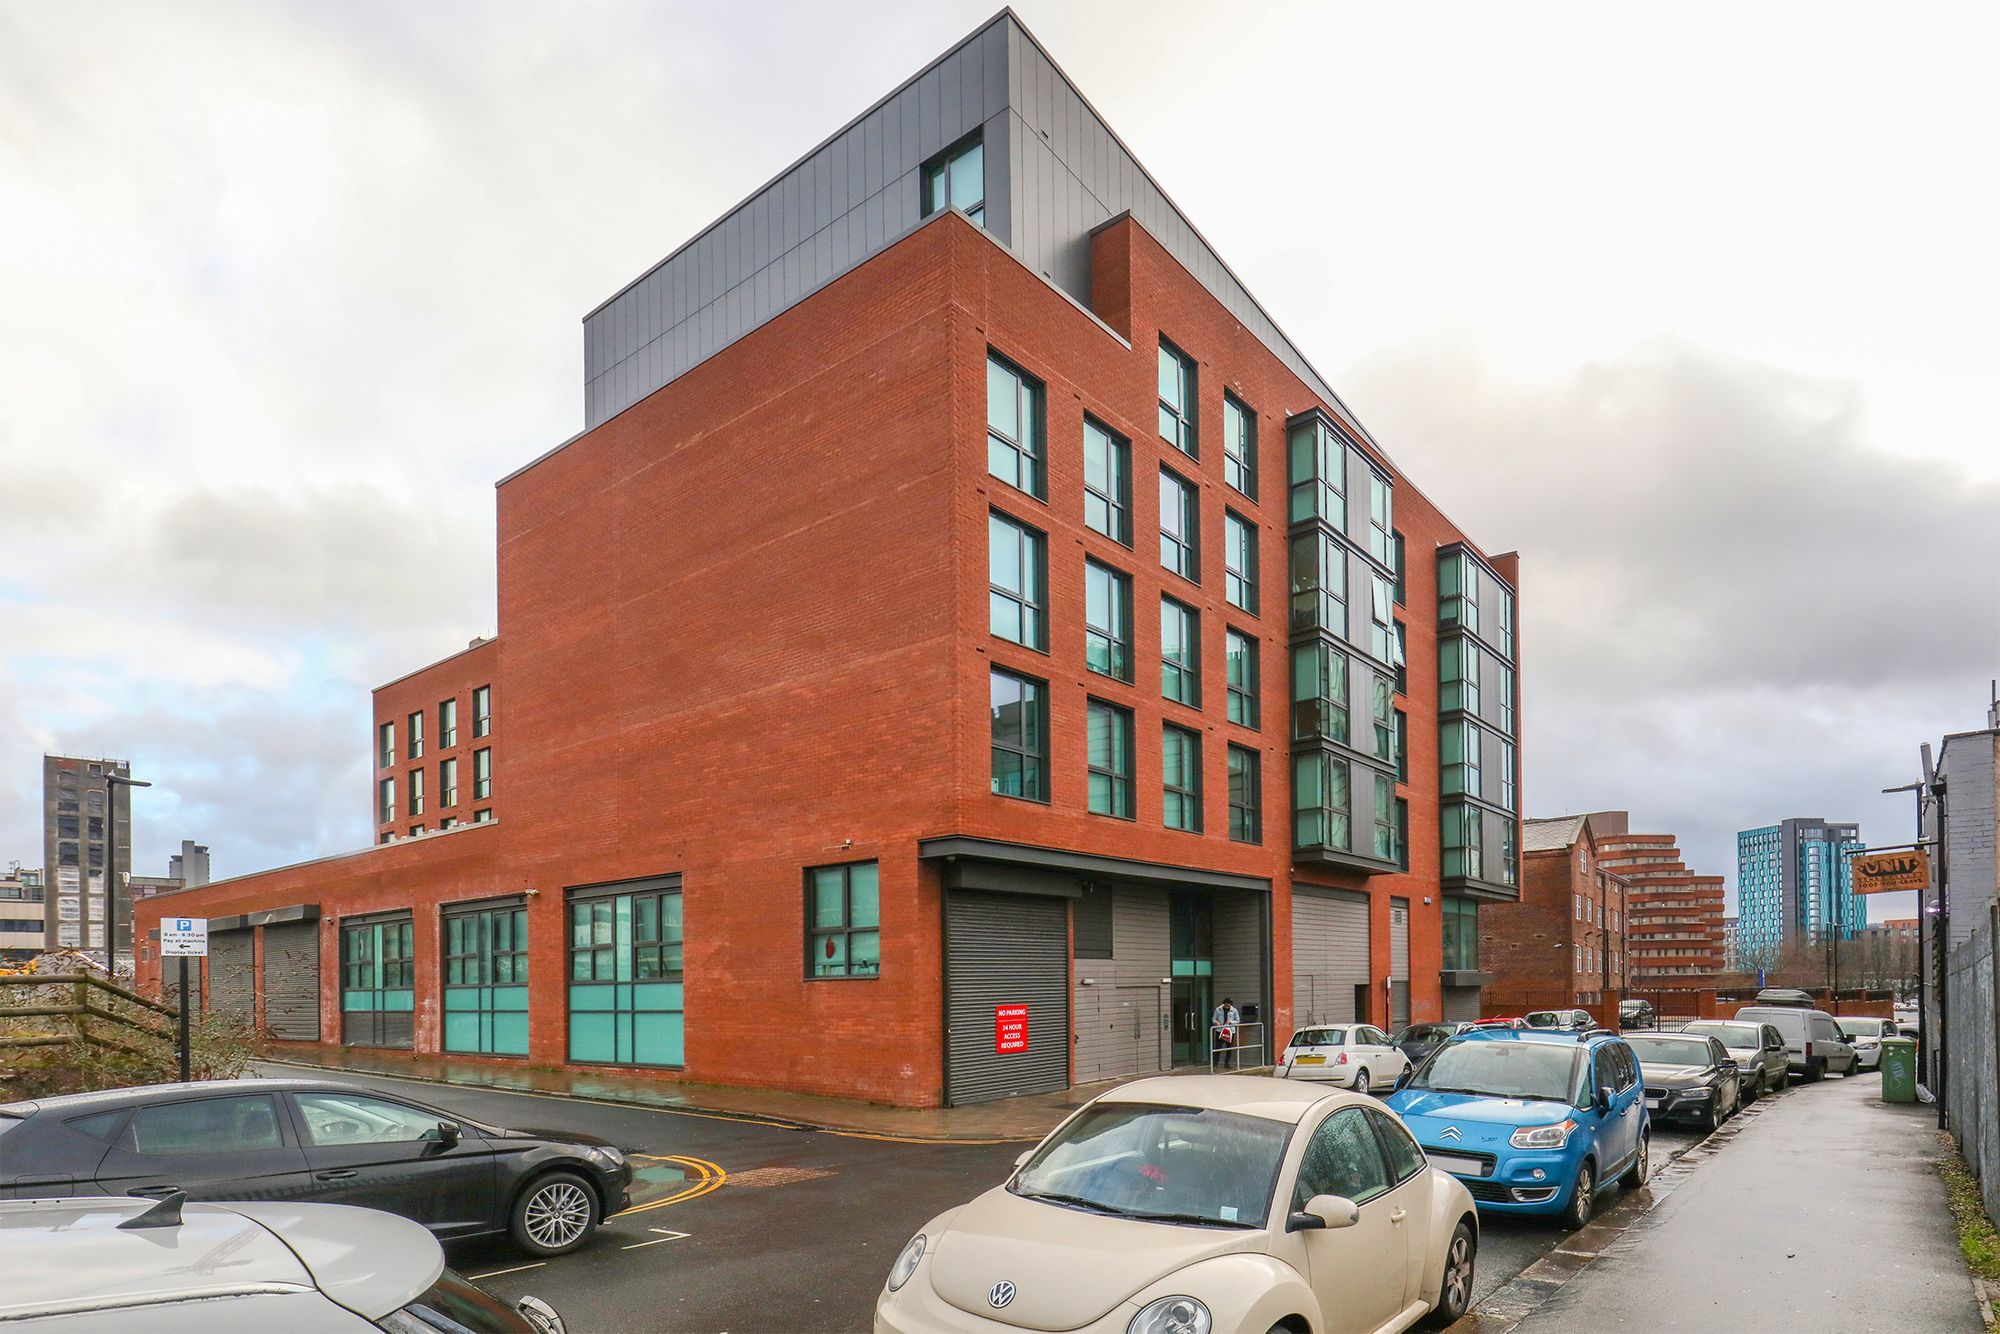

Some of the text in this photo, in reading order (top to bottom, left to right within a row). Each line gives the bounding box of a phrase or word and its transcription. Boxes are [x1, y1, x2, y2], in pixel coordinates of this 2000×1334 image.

[1863, 858, 1911, 874] UNIT
[1003, 1032, 1021, 1040] ACCESS
[1000, 1040, 1024, 1048] REQUIRED
